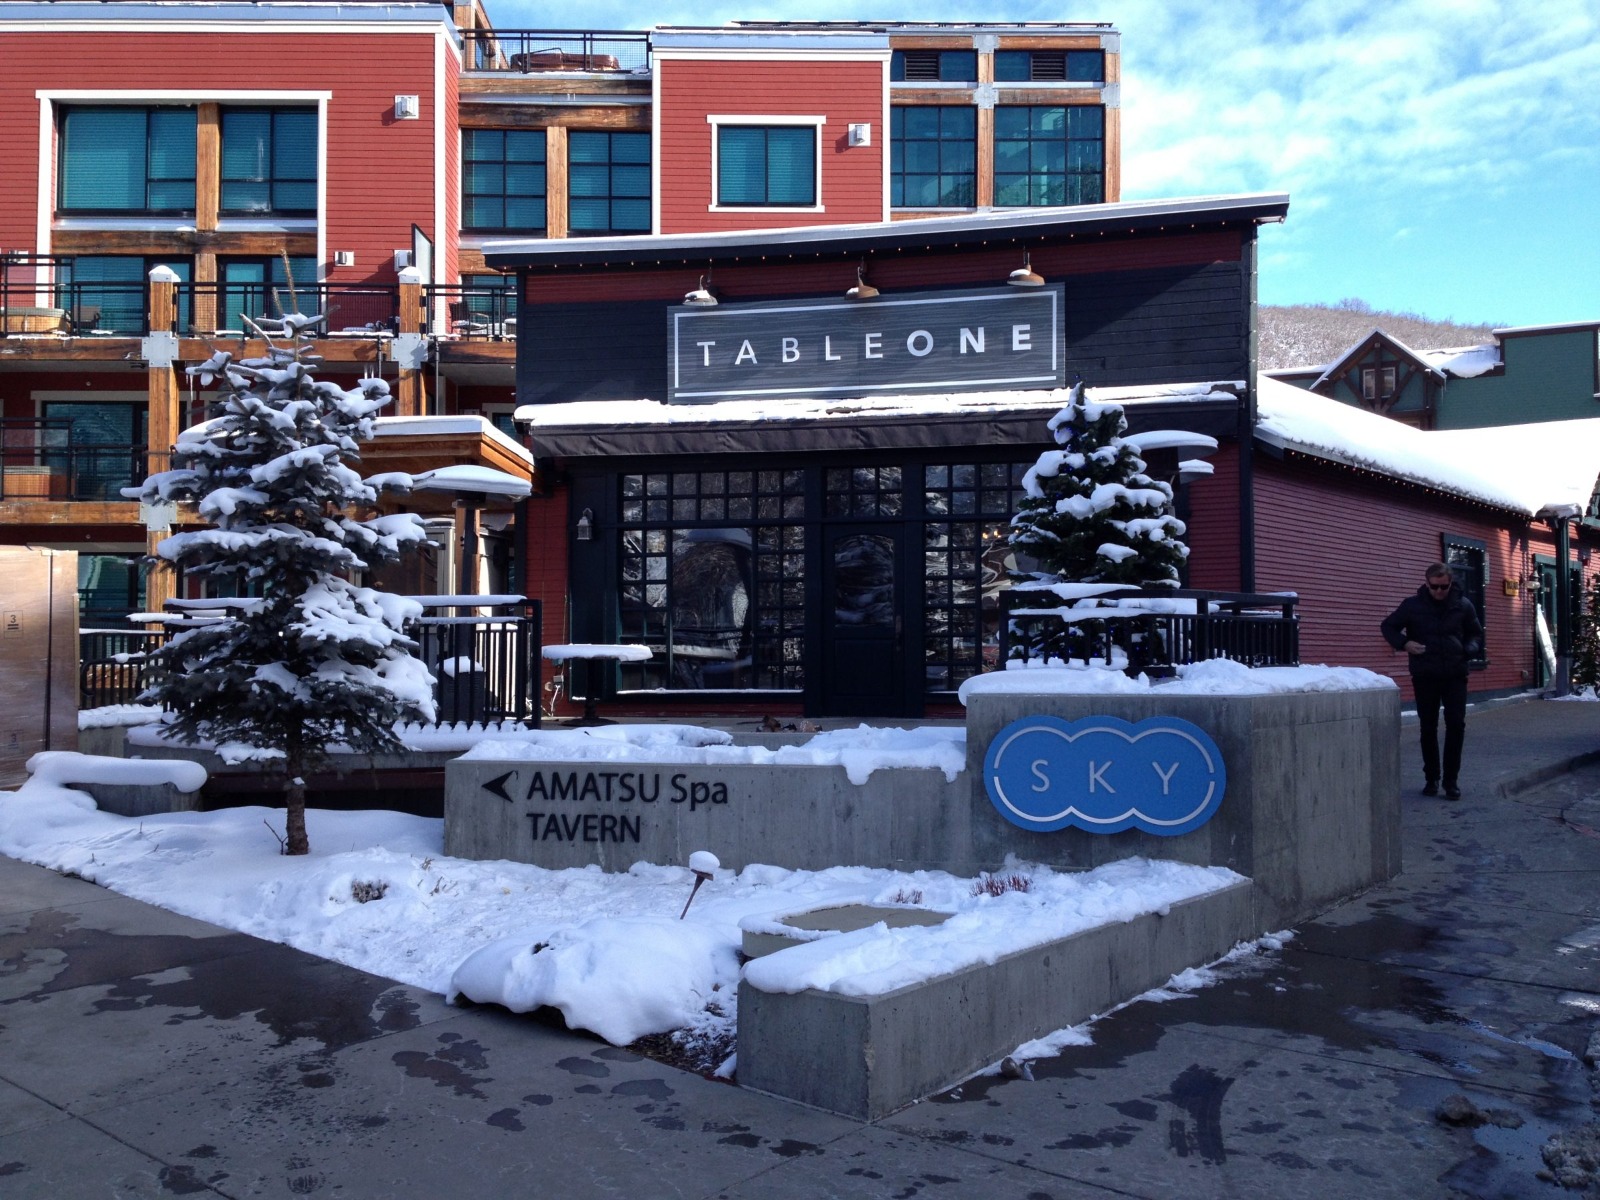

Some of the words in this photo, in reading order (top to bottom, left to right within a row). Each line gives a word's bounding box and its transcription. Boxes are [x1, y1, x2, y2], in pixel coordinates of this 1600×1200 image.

[526, 771, 660, 803] AMATSU
[670, 774, 728, 812] Spa
[1030, 758, 1180, 795] SKY
[526, 812, 641, 843] TAVERN
